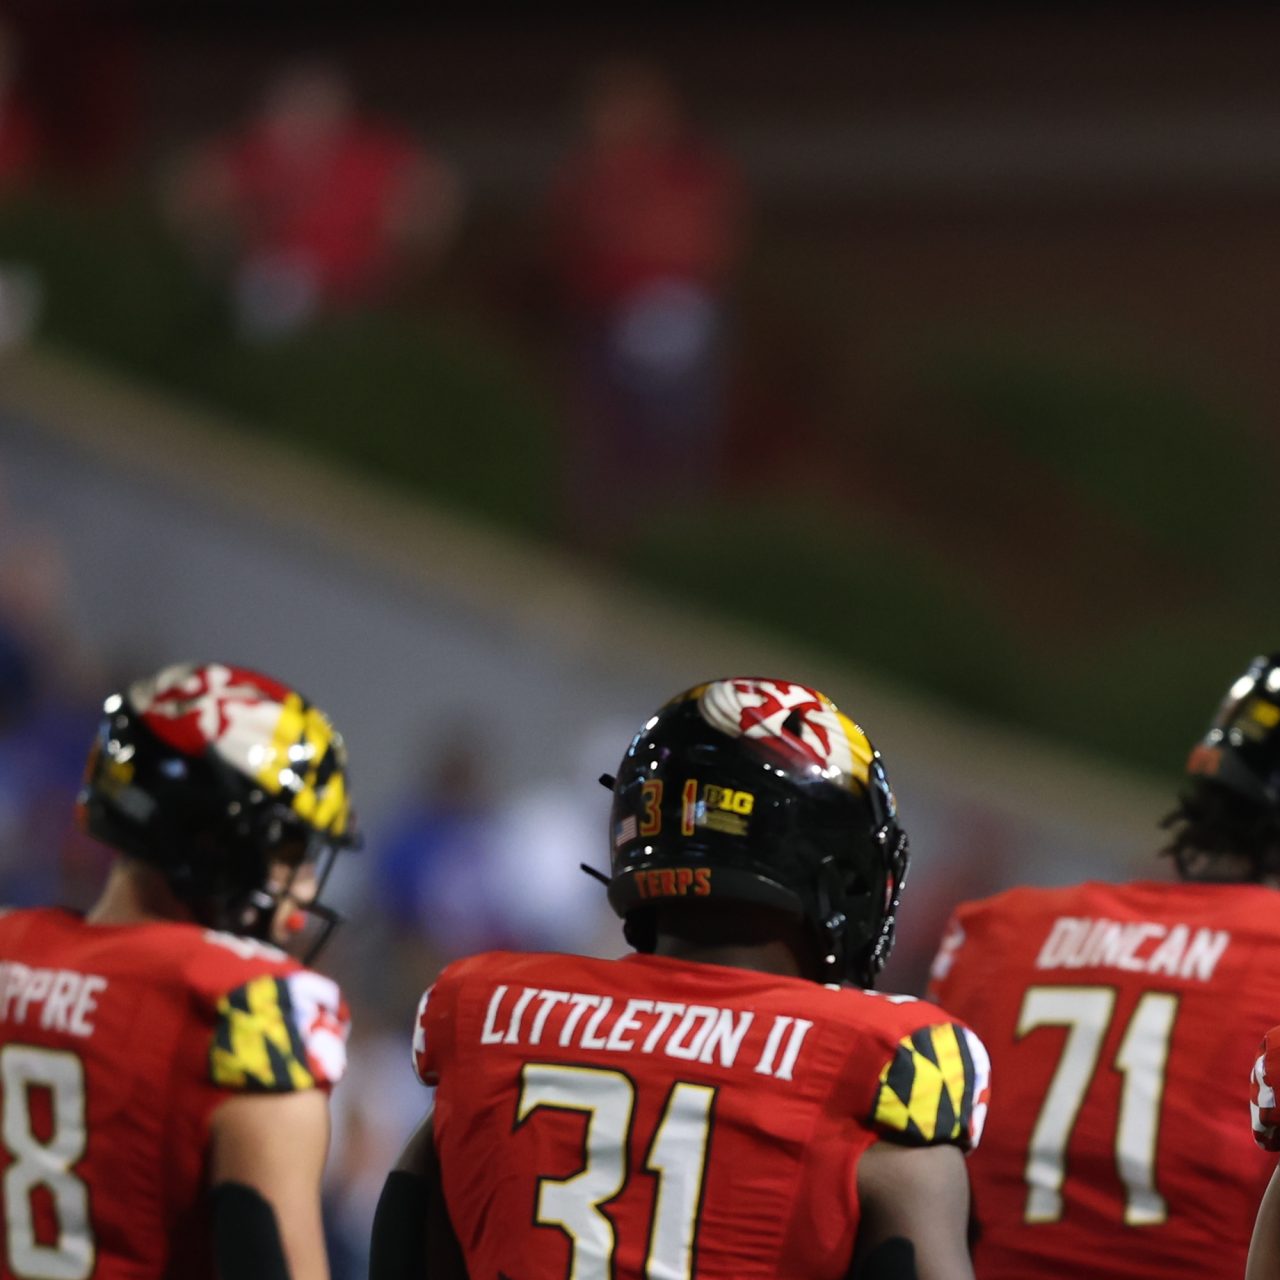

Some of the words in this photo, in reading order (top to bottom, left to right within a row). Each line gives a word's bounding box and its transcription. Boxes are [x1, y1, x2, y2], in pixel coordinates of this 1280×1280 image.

[640, 779, 698, 836] 31
[633, 867, 711, 898] TERPS
[1036, 916, 1230, 982] DUNCAN
[480, 985, 753, 1068] LITTLETON
[755, 1015, 814, 1081] II
[1016, 985, 1181, 1227] 71
